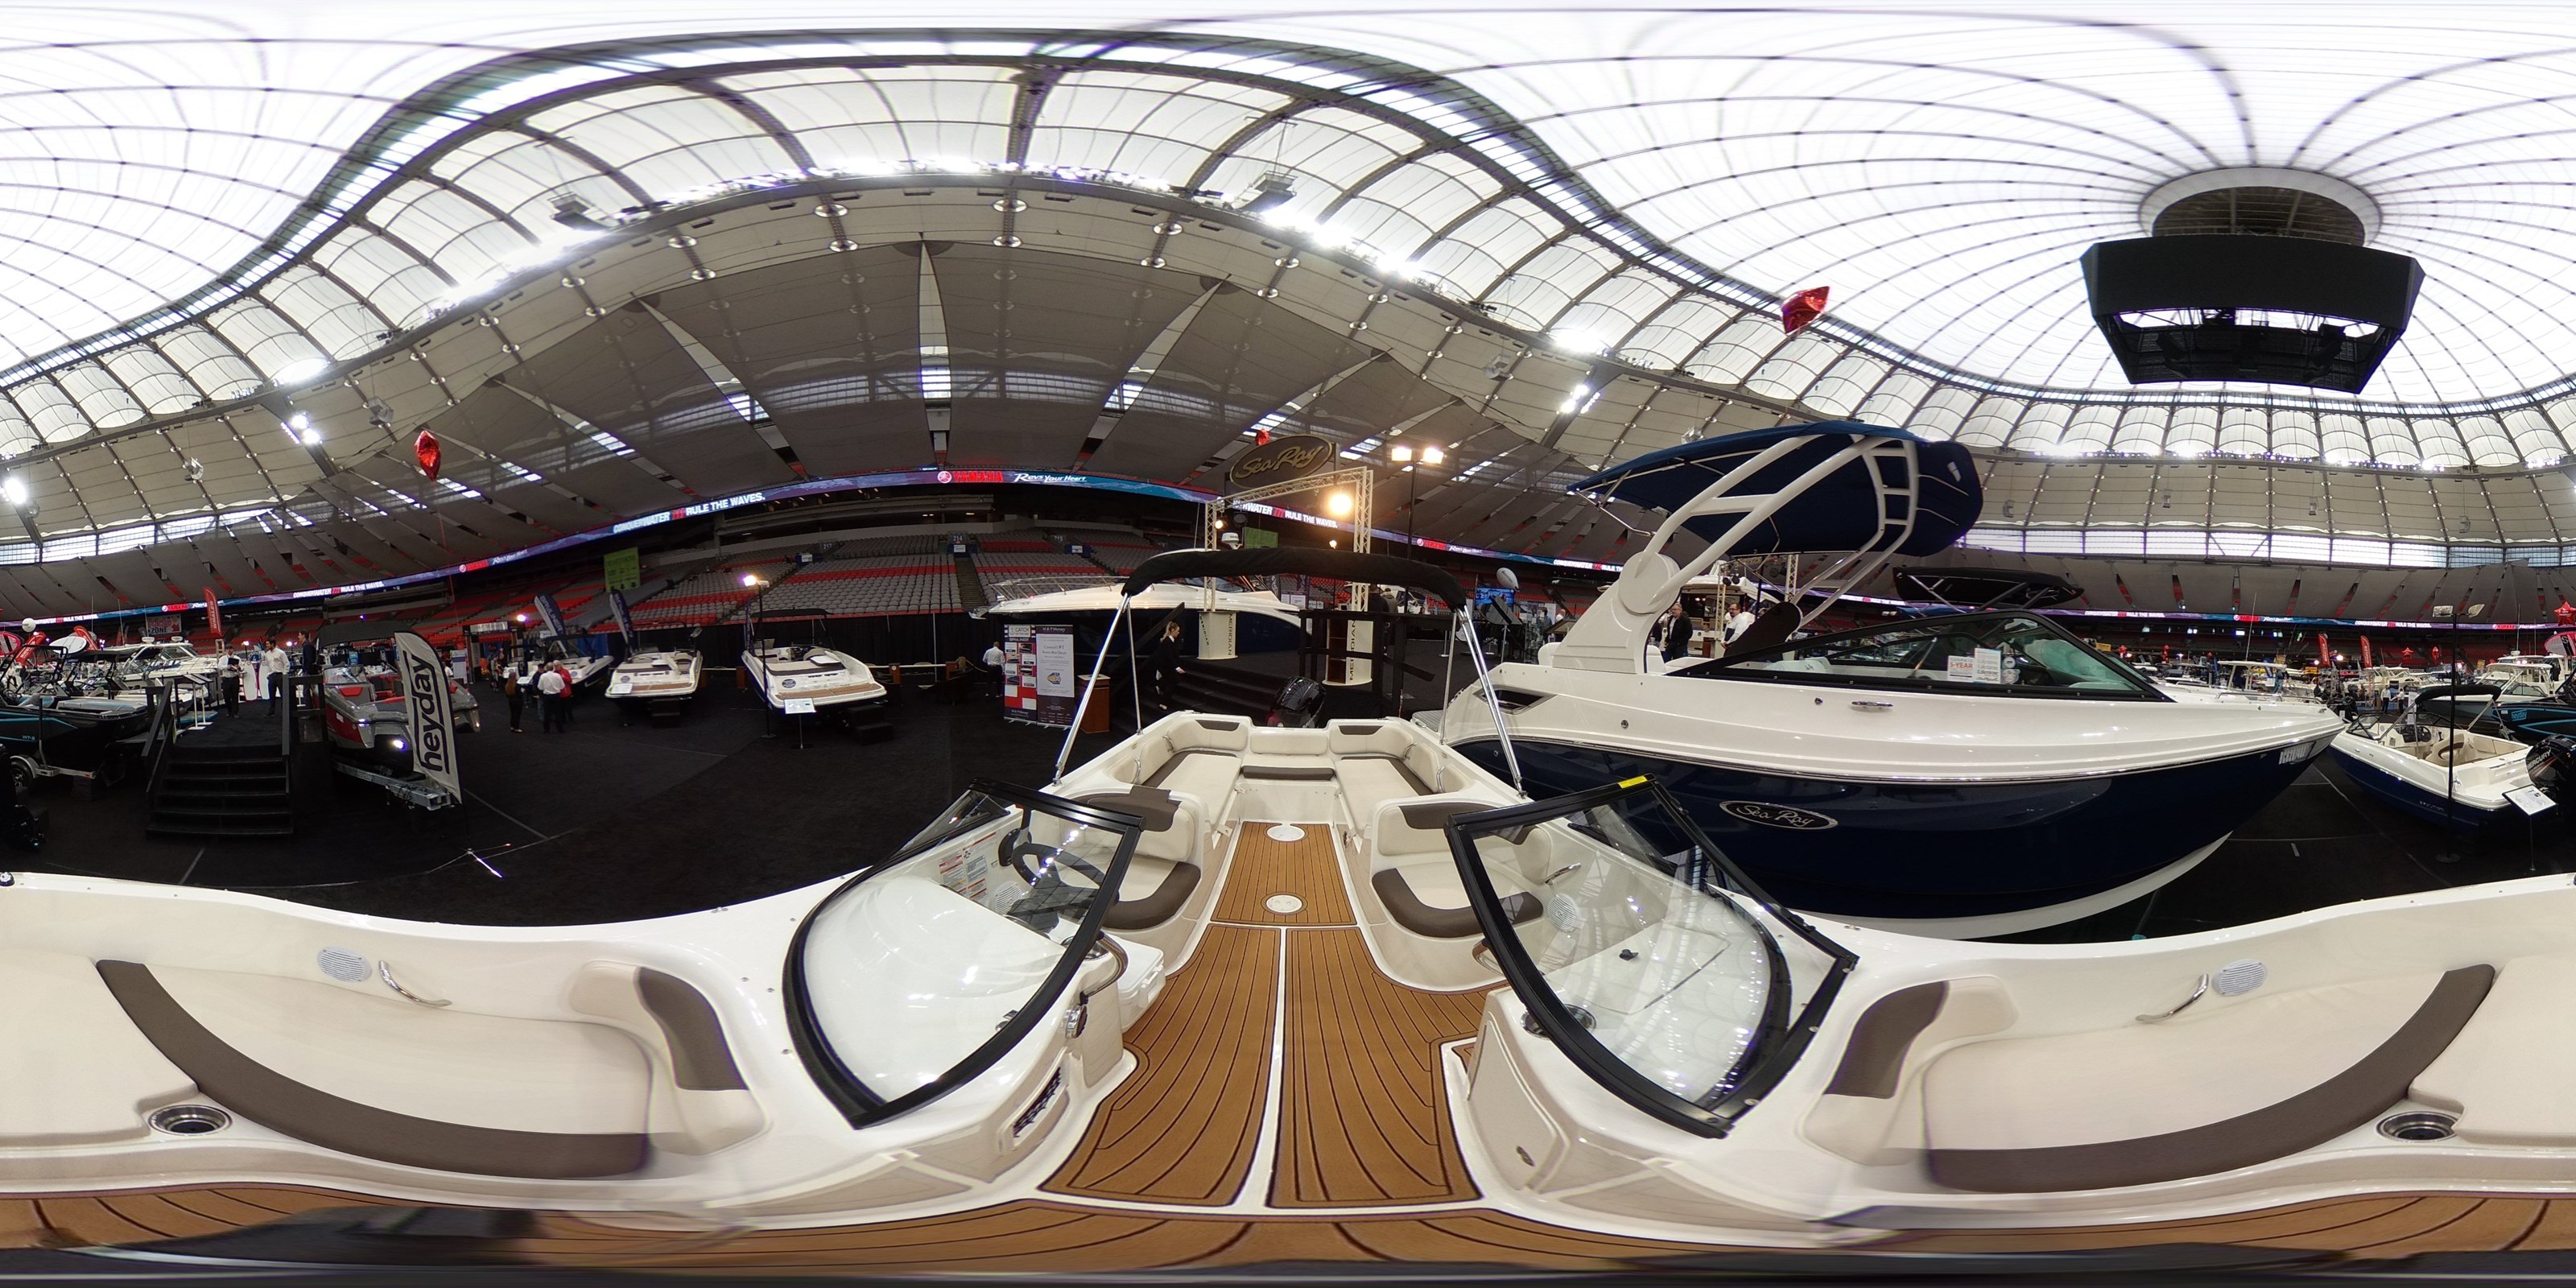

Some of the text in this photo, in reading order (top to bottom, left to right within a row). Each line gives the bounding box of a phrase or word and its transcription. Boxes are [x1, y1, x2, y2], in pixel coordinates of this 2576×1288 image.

[1235, 445, 1324, 479] Sea Ray
[953, 471, 1003, 482] YAMAHA
[686, 505, 709, 516] RULE
[710, 498, 729, 510] THE
[1285, 510, 1302, 521] RULE
[1302, 514, 1315, 524] THE
[355, 583, 365, 591] THE
[405, 650, 449, 774] heyday
[1736, 805, 1815, 828] Sea Ray
